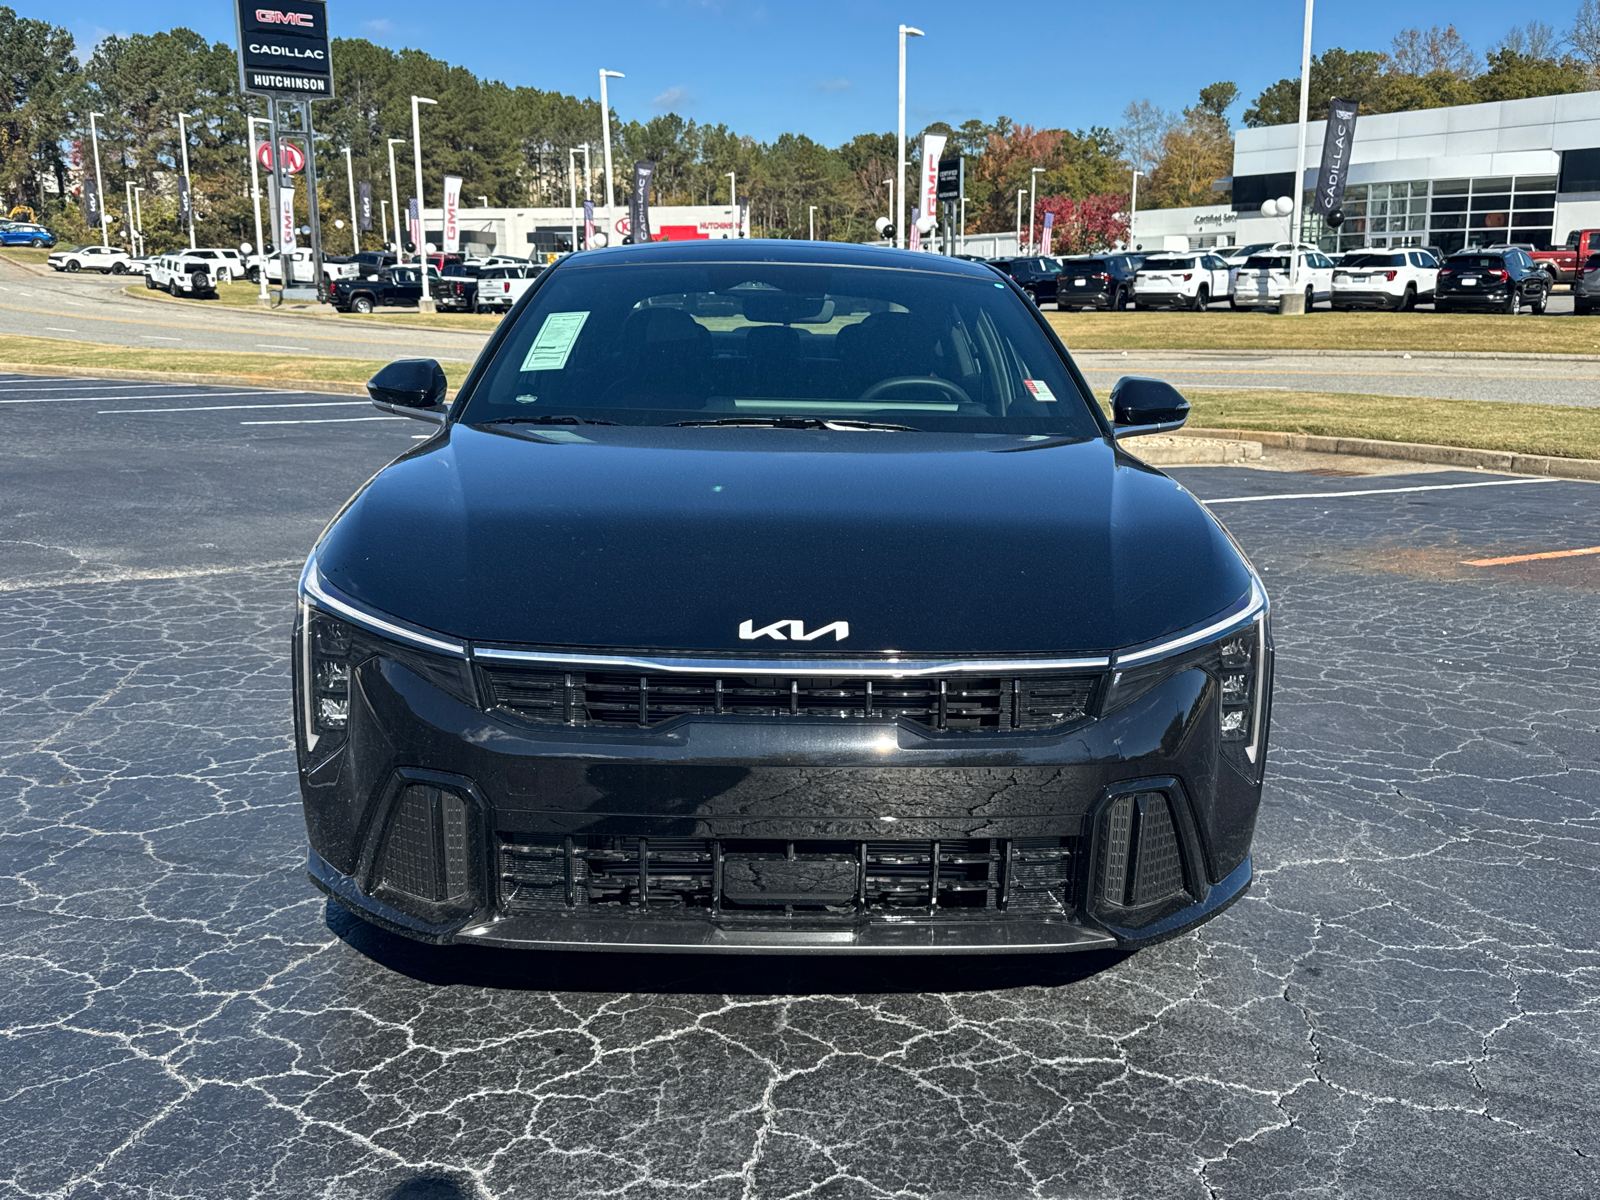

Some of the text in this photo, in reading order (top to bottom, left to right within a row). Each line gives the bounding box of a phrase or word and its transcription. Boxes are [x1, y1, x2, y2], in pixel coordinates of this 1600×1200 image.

[255, 8, 314, 28] GMC
[249, 43, 324, 60] CADILLAC
[254, 74, 325, 91] HUTCHINSON
[927, 154, 939, 216] GMC
[1324, 124, 1346, 209] CADILLAC
[284, 200, 293, 244] GMC
[446, 192, 456, 240] GMC
[637, 177, 647, 241] CADILLAC
[738, 618, 850, 642] KIA
